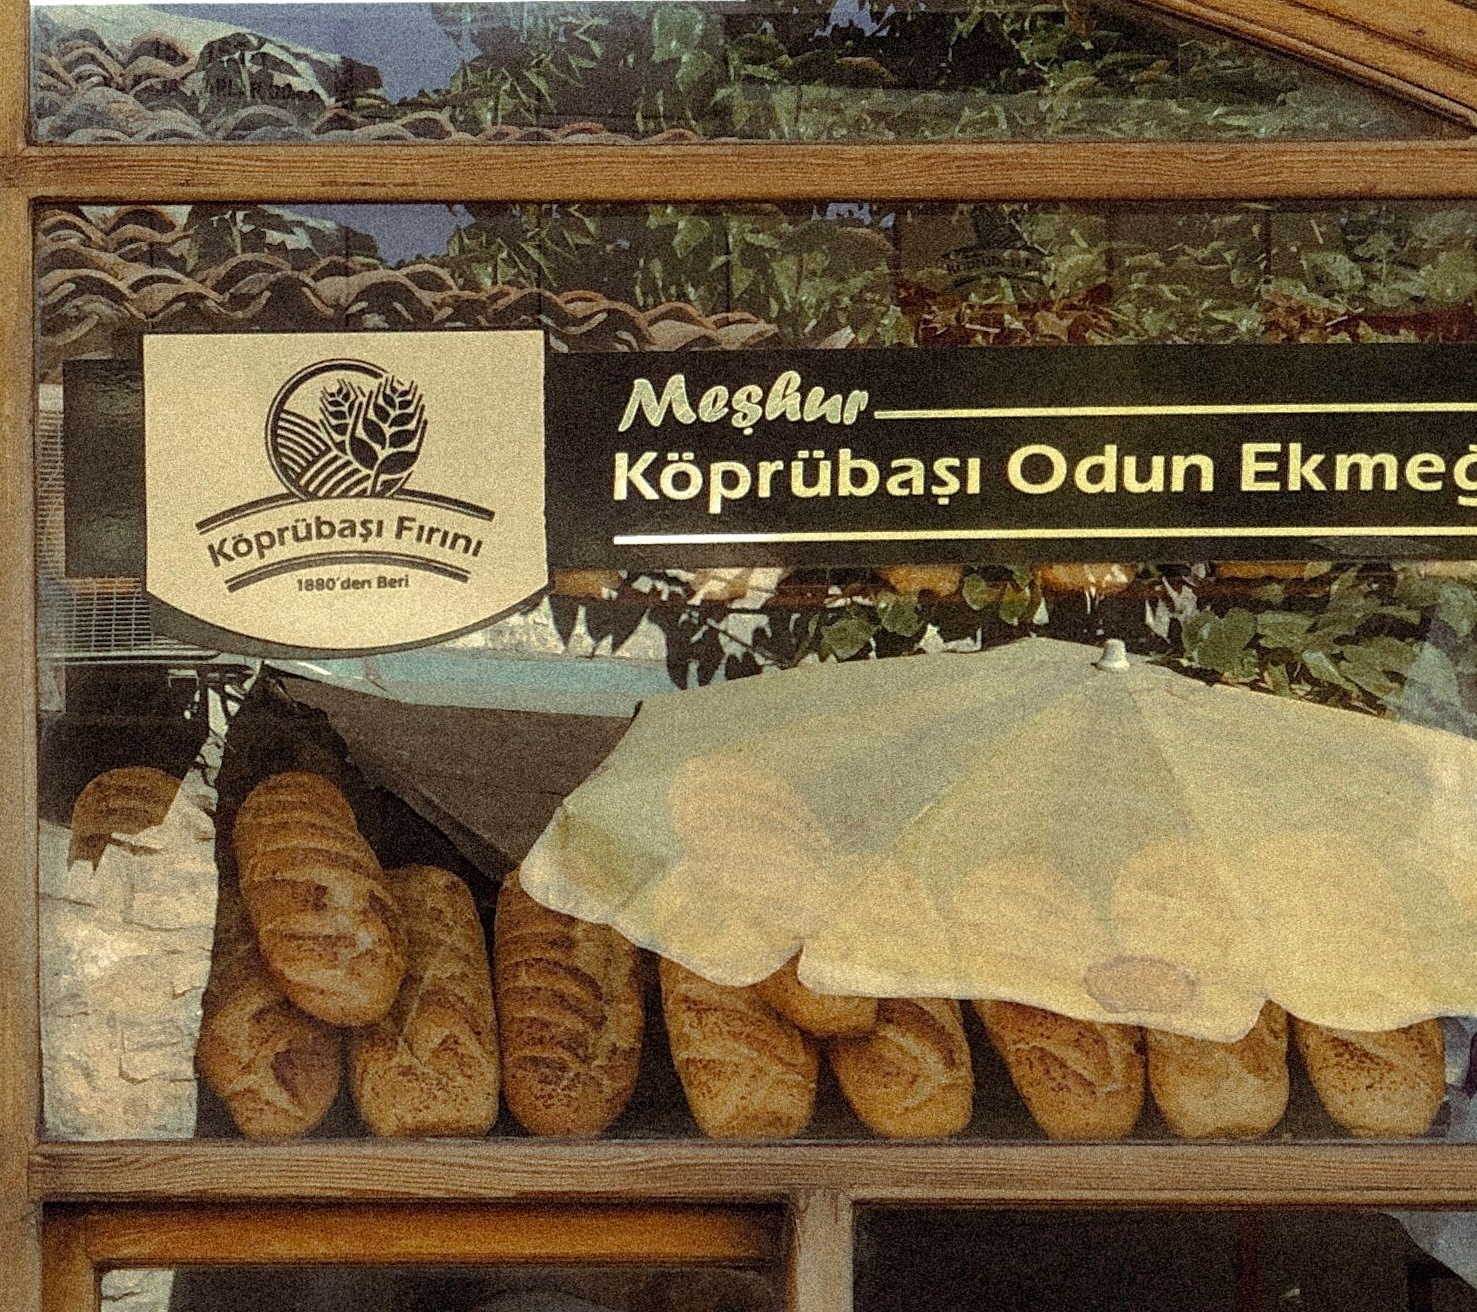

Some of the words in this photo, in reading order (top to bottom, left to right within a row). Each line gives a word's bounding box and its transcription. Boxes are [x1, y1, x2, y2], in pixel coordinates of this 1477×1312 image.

[618, 370, 869, 435] Meşhur
[613, 448, 982, 515] Köprübaşı
[1006, 443, 1215, 495] Odun
[207, 516, 383, 567] Köprübaşı
[394, 515, 484, 558] Fırını
[296, 577, 372, 592] 1880'den
[376, 574, 410, 589] Beri
